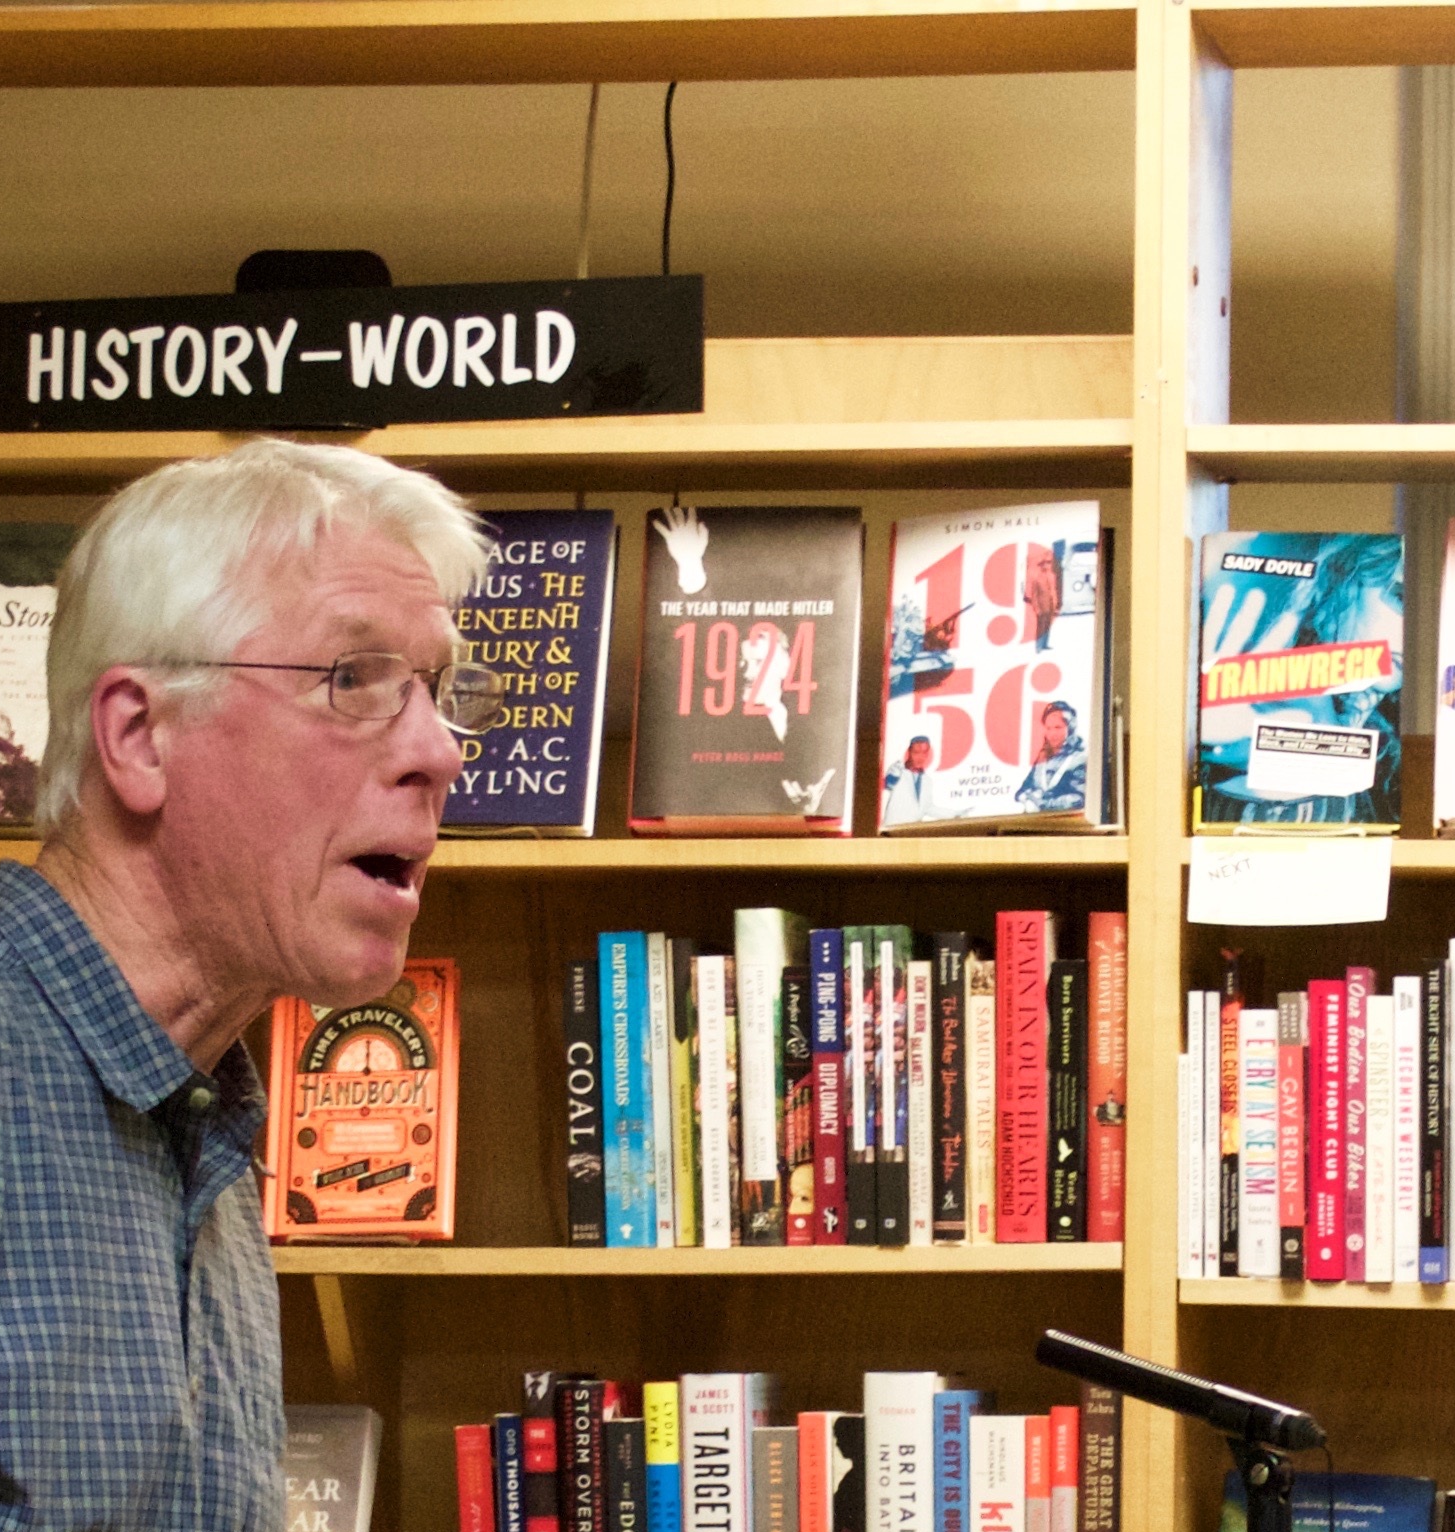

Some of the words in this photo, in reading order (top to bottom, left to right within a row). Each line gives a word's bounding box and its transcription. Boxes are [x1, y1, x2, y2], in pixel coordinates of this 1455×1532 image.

[28, 310, 576, 403] HISTORY-WORLD
[487, 541, 546, 565] AGE
[552, 540, 586, 561] OF
[944, 518, 995, 535] SIMON
[1003, 516, 1040, 530] HALL
[542, 572, 585, 599] THE
[1224, 556, 1261, 572] SADY
[1264, 559, 1314, 578] DOYLE
[661, 600, 680, 616] THE
[683, 600, 718, 616] YEAR
[720, 600, 751, 616] THAT
[754, 600, 790, 616] MADE
[792, 599, 833, 616] HITLER
[467, 639, 541, 669] TURY
[546, 640, 571, 664] &
[544, 672, 579, 693] OF
[673, 621, 818, 717] 1924
[1206, 646, 1383, 700] TRAINWRECK
[512, 739, 570, 762] A.C.
[958, 774, 1002, 788] WORLD
[967, 784, 1011, 798] REVOLT
[610, 943, 628, 1011] EMPIRE'S
[1017, 920, 1039, 992] SPAIN
[817, 973, 836, 1044] PING-PONG
[1017, 1002, 1039, 1030] IN
[1325, 993, 1339, 1073] FEMINIST
[310, 1027, 339, 1070] TIME
[339, 1010, 426, 1068] TRAVELER'S
[612, 1017, 629, 1108] CROSSROADS
[1017, 1038, 1039, 1100] OUR
[298, 1071, 433, 1118] HANDBOOK
[566, 1042, 596, 1146] COAL
[817, 1061, 838, 1136] DIPLOMACY
[1017, 1112, 1039, 1219] HEARTS
[574, 1387, 589, 1463] STORM
[693, 1427, 731, 1531] TARGET
